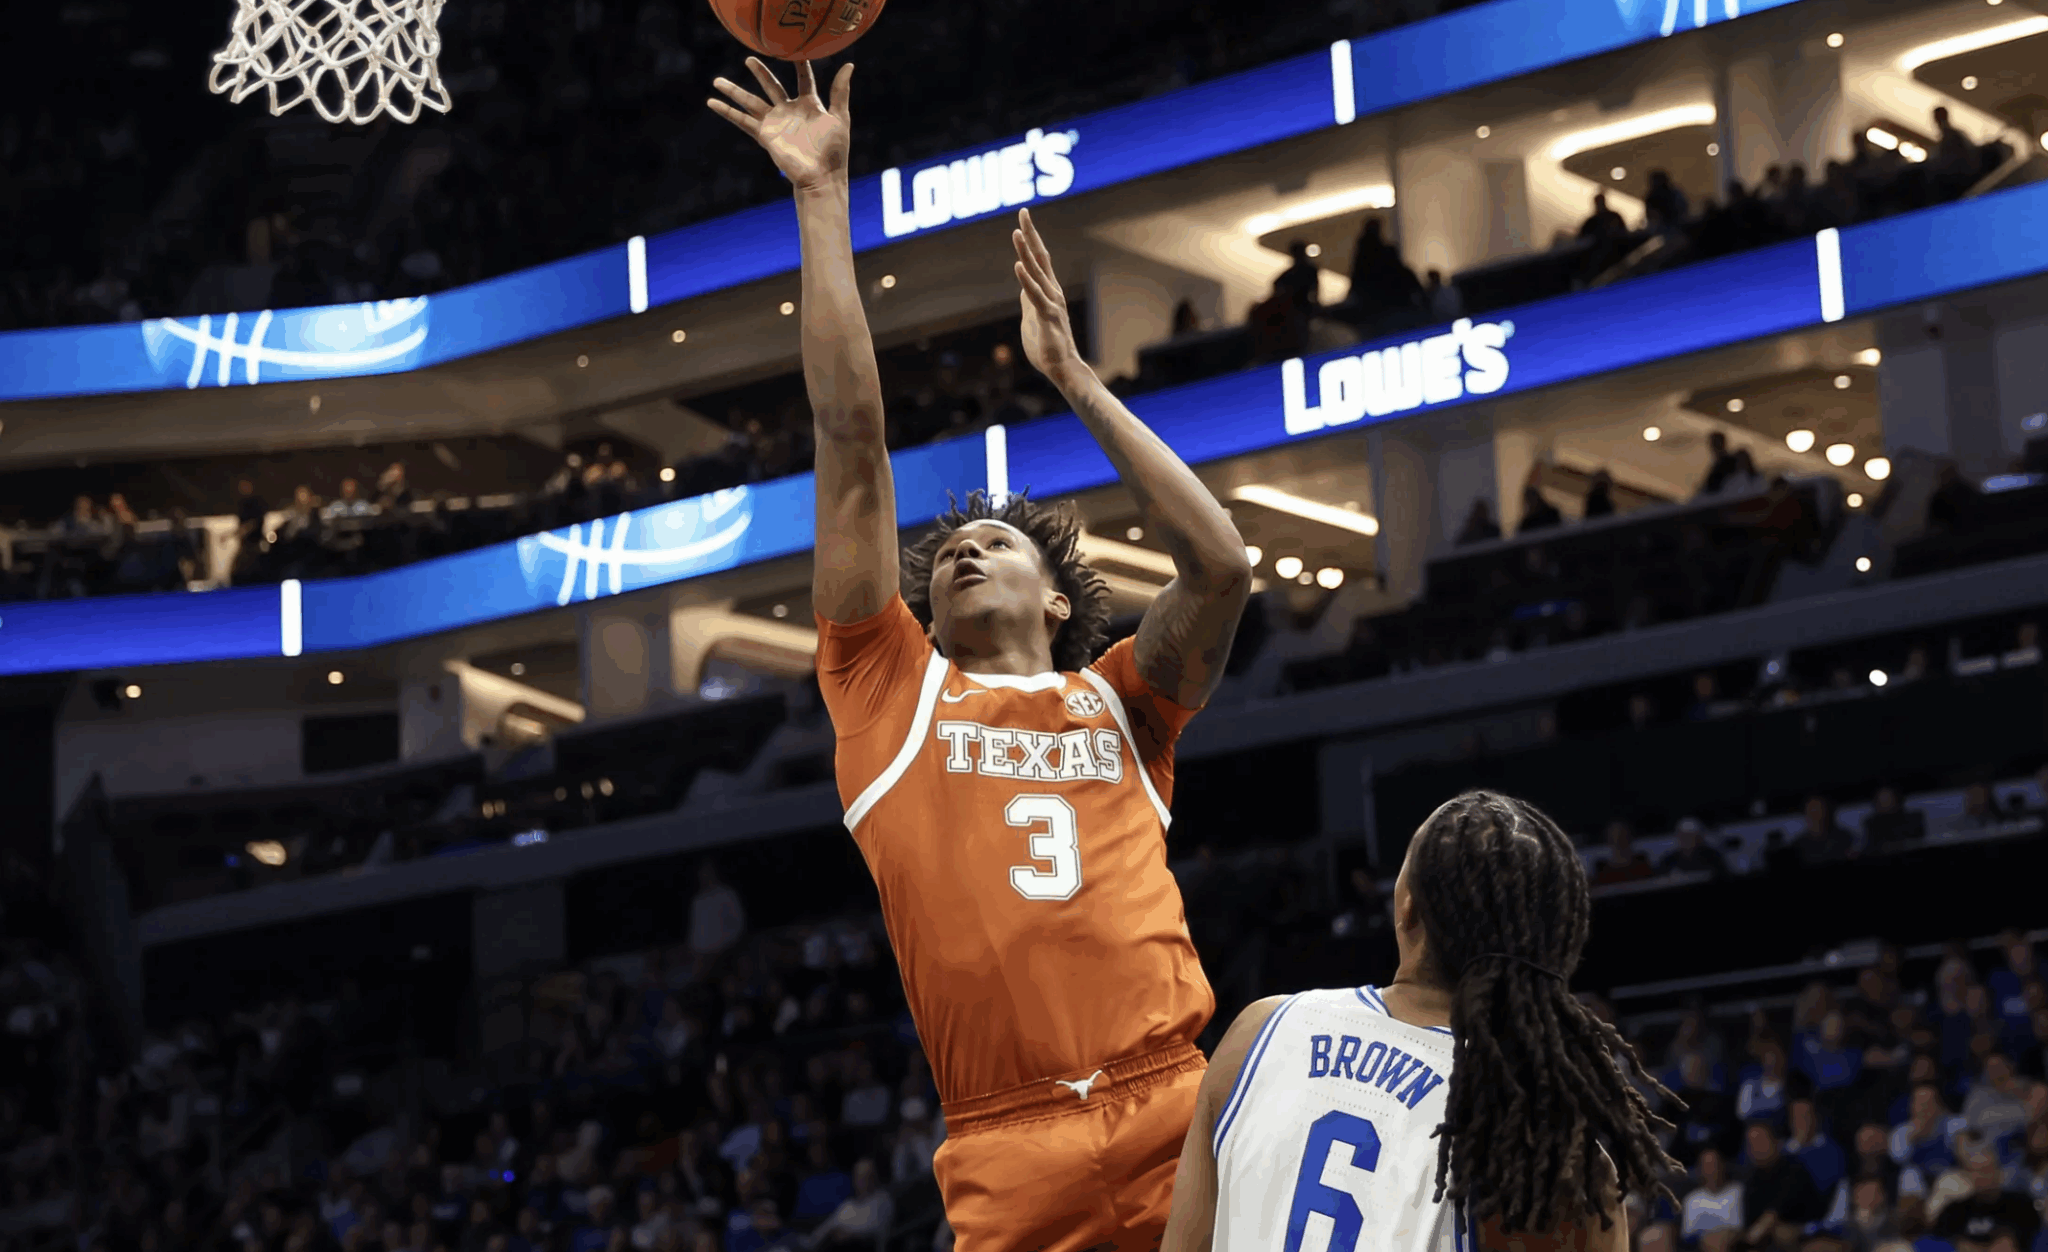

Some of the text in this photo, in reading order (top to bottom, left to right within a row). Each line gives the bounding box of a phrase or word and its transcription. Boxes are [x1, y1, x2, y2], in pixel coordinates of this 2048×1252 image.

[1067, 692, 1104, 716] SEC
[937, 720, 1123, 784] TEXAS
[1004, 793, 1082, 900] 3
[1308, 1034, 1444, 1110] BROWN
[1283, 1109, 1382, 1252] 6
